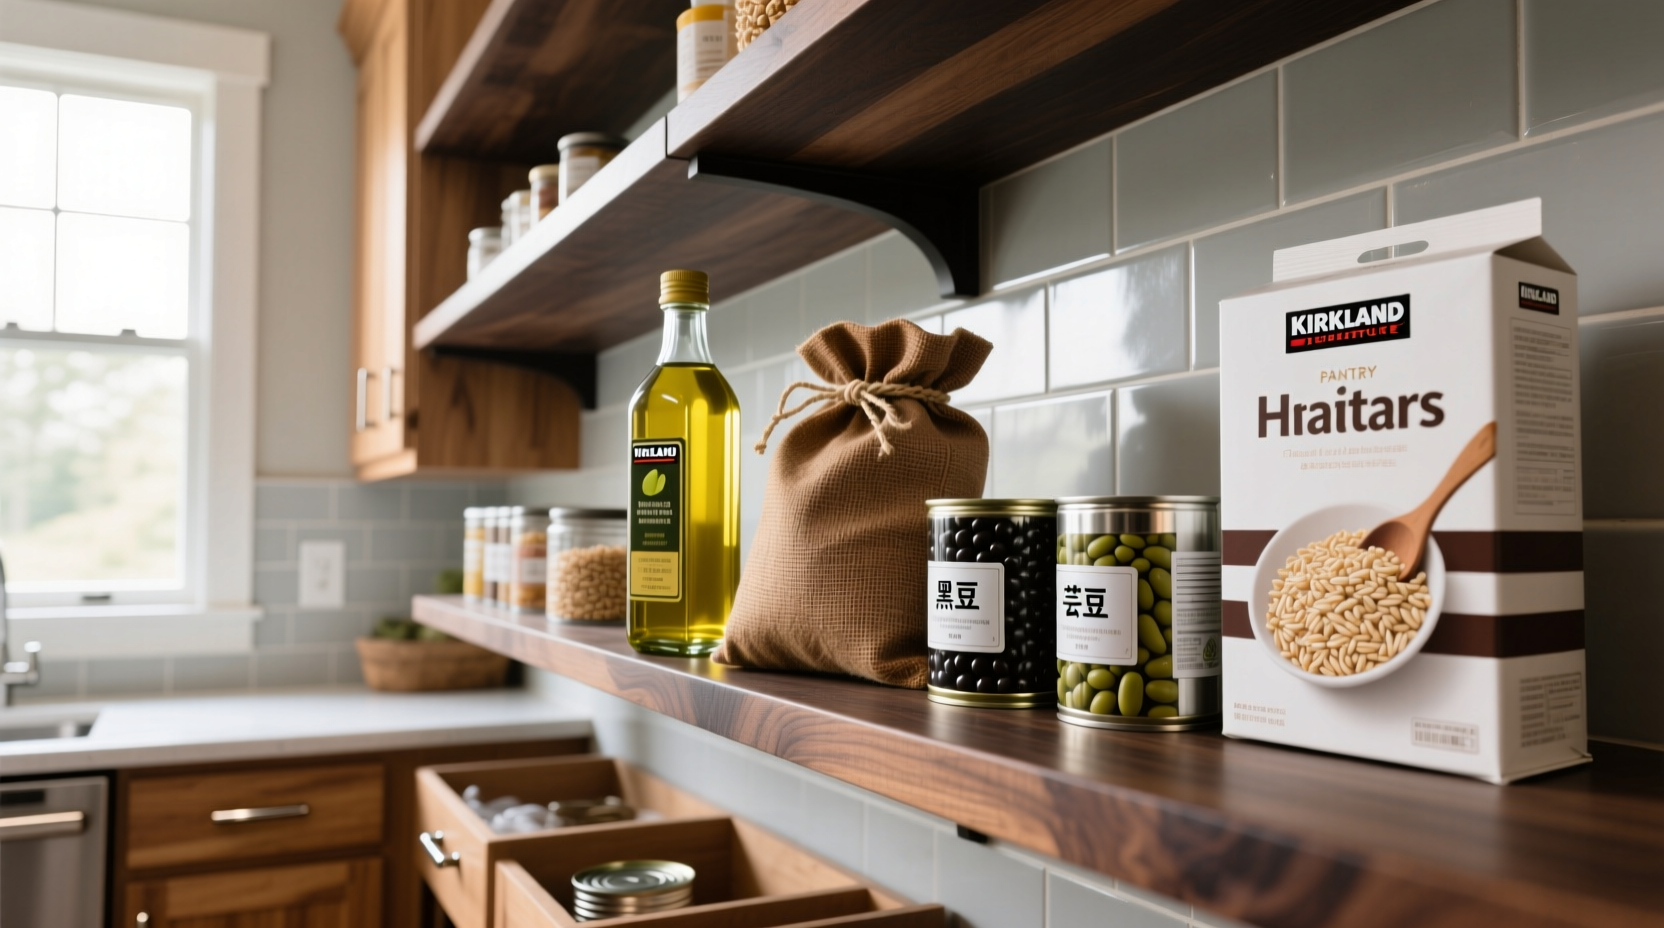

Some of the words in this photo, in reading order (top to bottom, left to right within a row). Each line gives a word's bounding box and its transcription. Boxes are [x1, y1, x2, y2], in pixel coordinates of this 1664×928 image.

[1291, 301, 1404, 336] KIRKLAND
[1320, 365, 1377, 383] PANTRY
[1258, 386, 1445, 438] Hraitars
[936, 580, 980, 610] 黑豆
[1063, 585, 1109, 618] 芸豆
